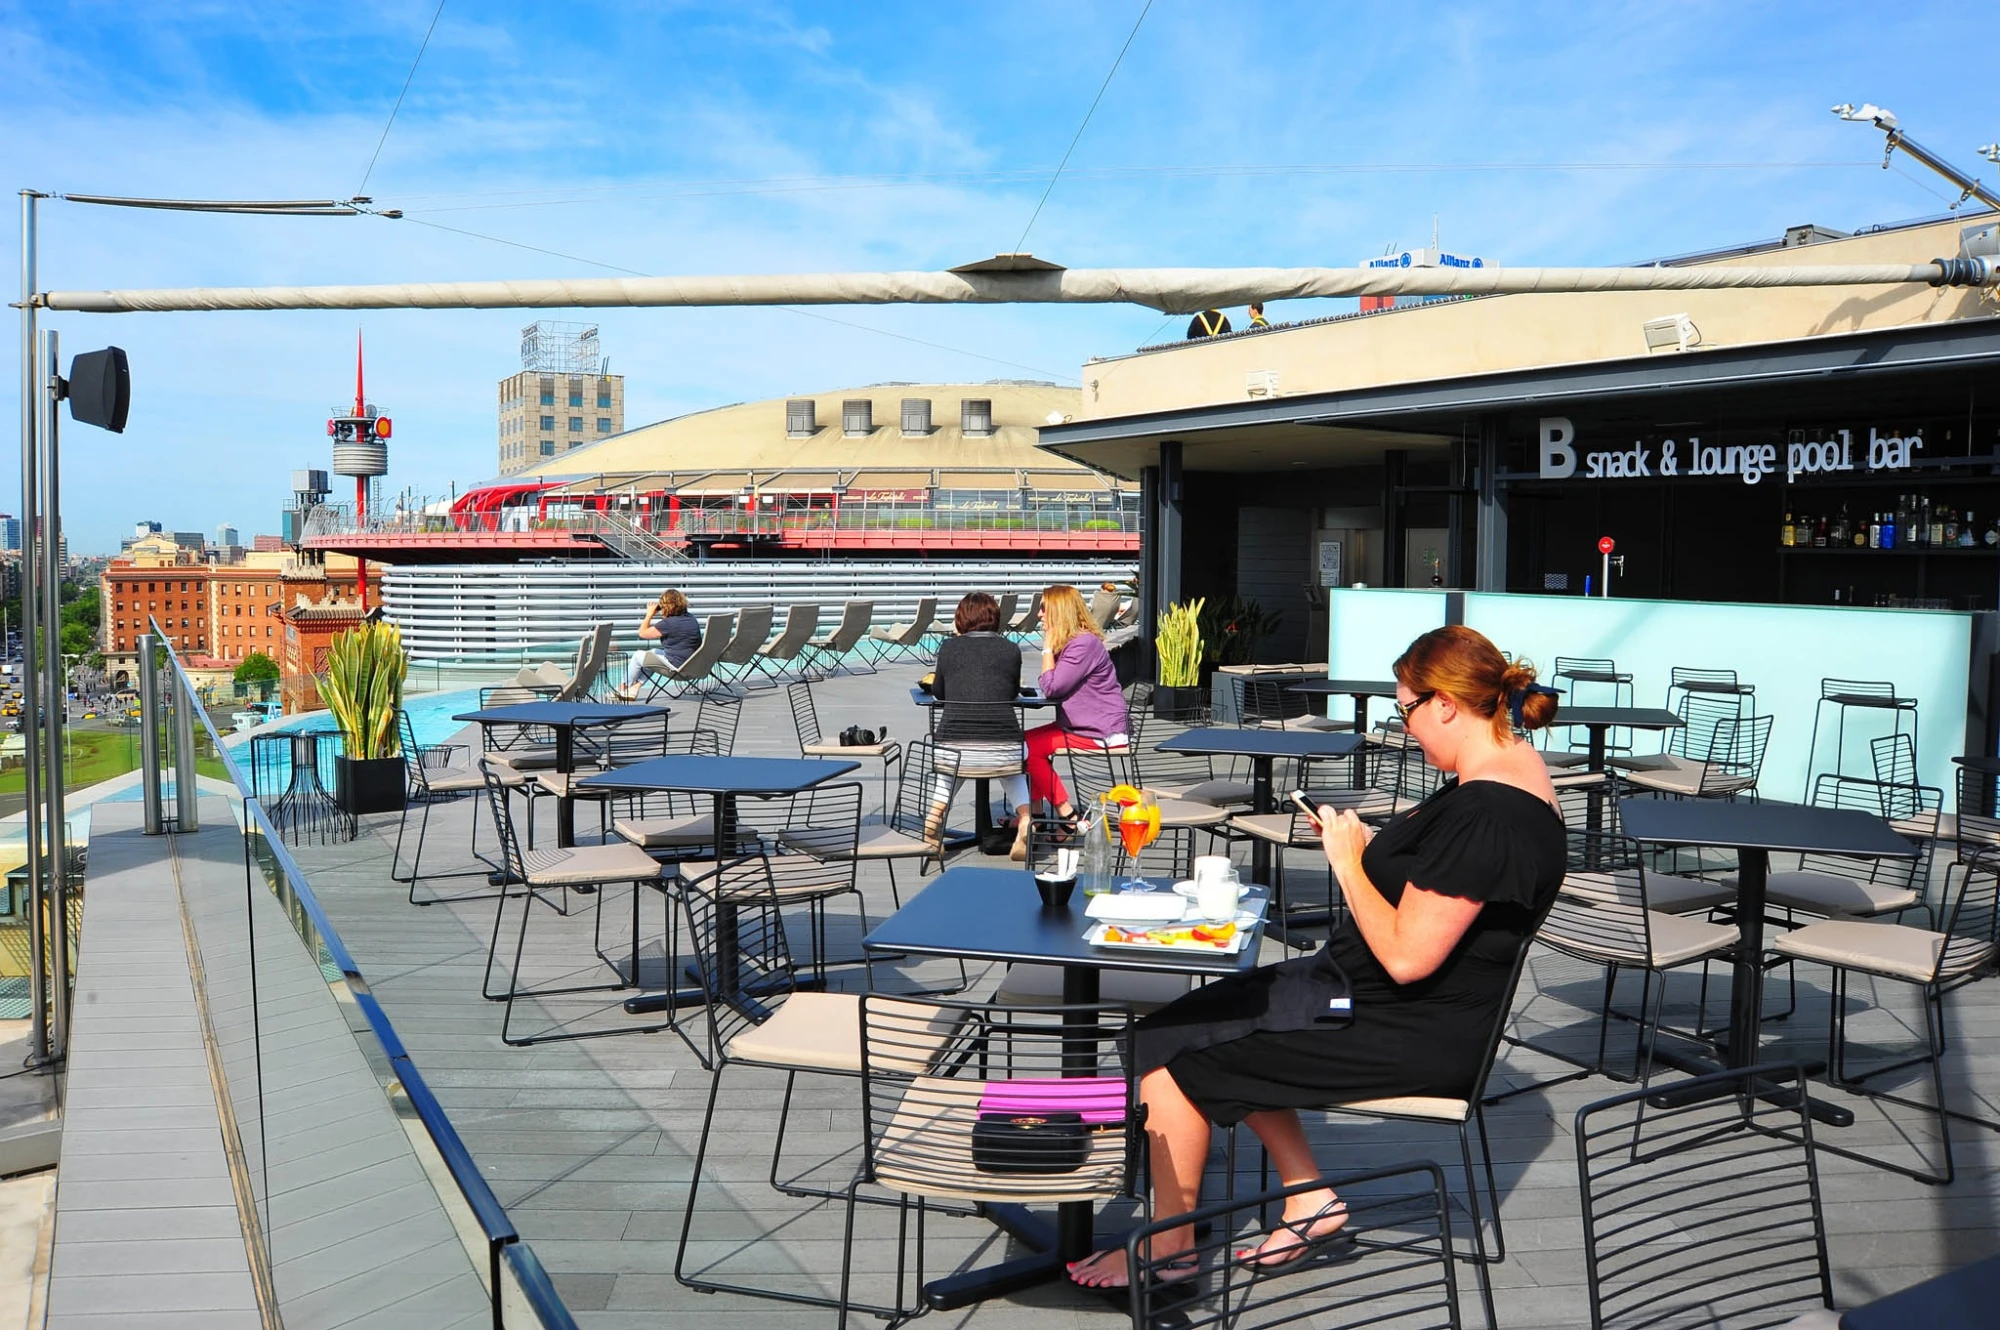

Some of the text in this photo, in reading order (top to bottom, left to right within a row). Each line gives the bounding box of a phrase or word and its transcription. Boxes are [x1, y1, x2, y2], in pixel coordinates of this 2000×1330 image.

[1369, 258, 1399, 268] Allianz
[1440, 253, 1470, 268] Allianz
[1539, 416, 1923, 485] B snack & lounge pool bar
